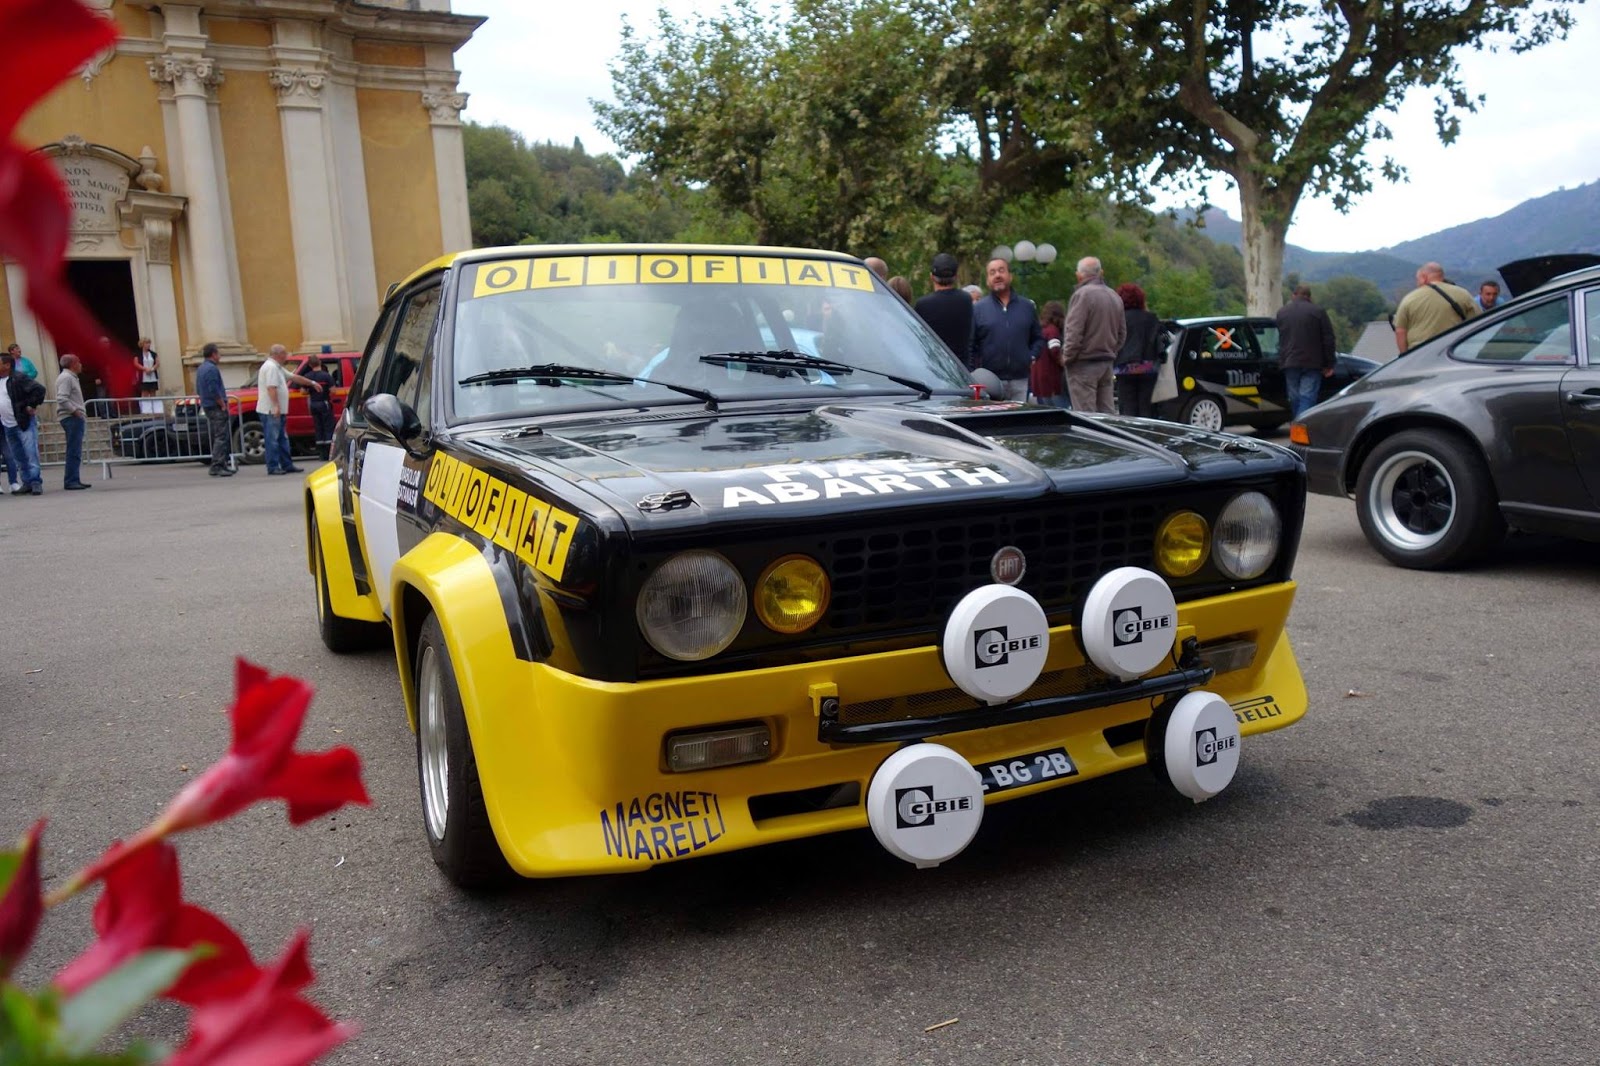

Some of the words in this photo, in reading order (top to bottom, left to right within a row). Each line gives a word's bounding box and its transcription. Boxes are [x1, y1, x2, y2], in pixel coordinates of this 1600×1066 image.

[64, 167, 91, 176] NON
[722, 466, 1010, 508] ABARTH
[999, 556, 1020, 577] FIAT
[1235, 704, 1282, 724] RELLI
[989, 760, 1033, 787] BG
[1034, 753, 1072, 778] 2B
[600, 791, 725, 838] MAGNETI
